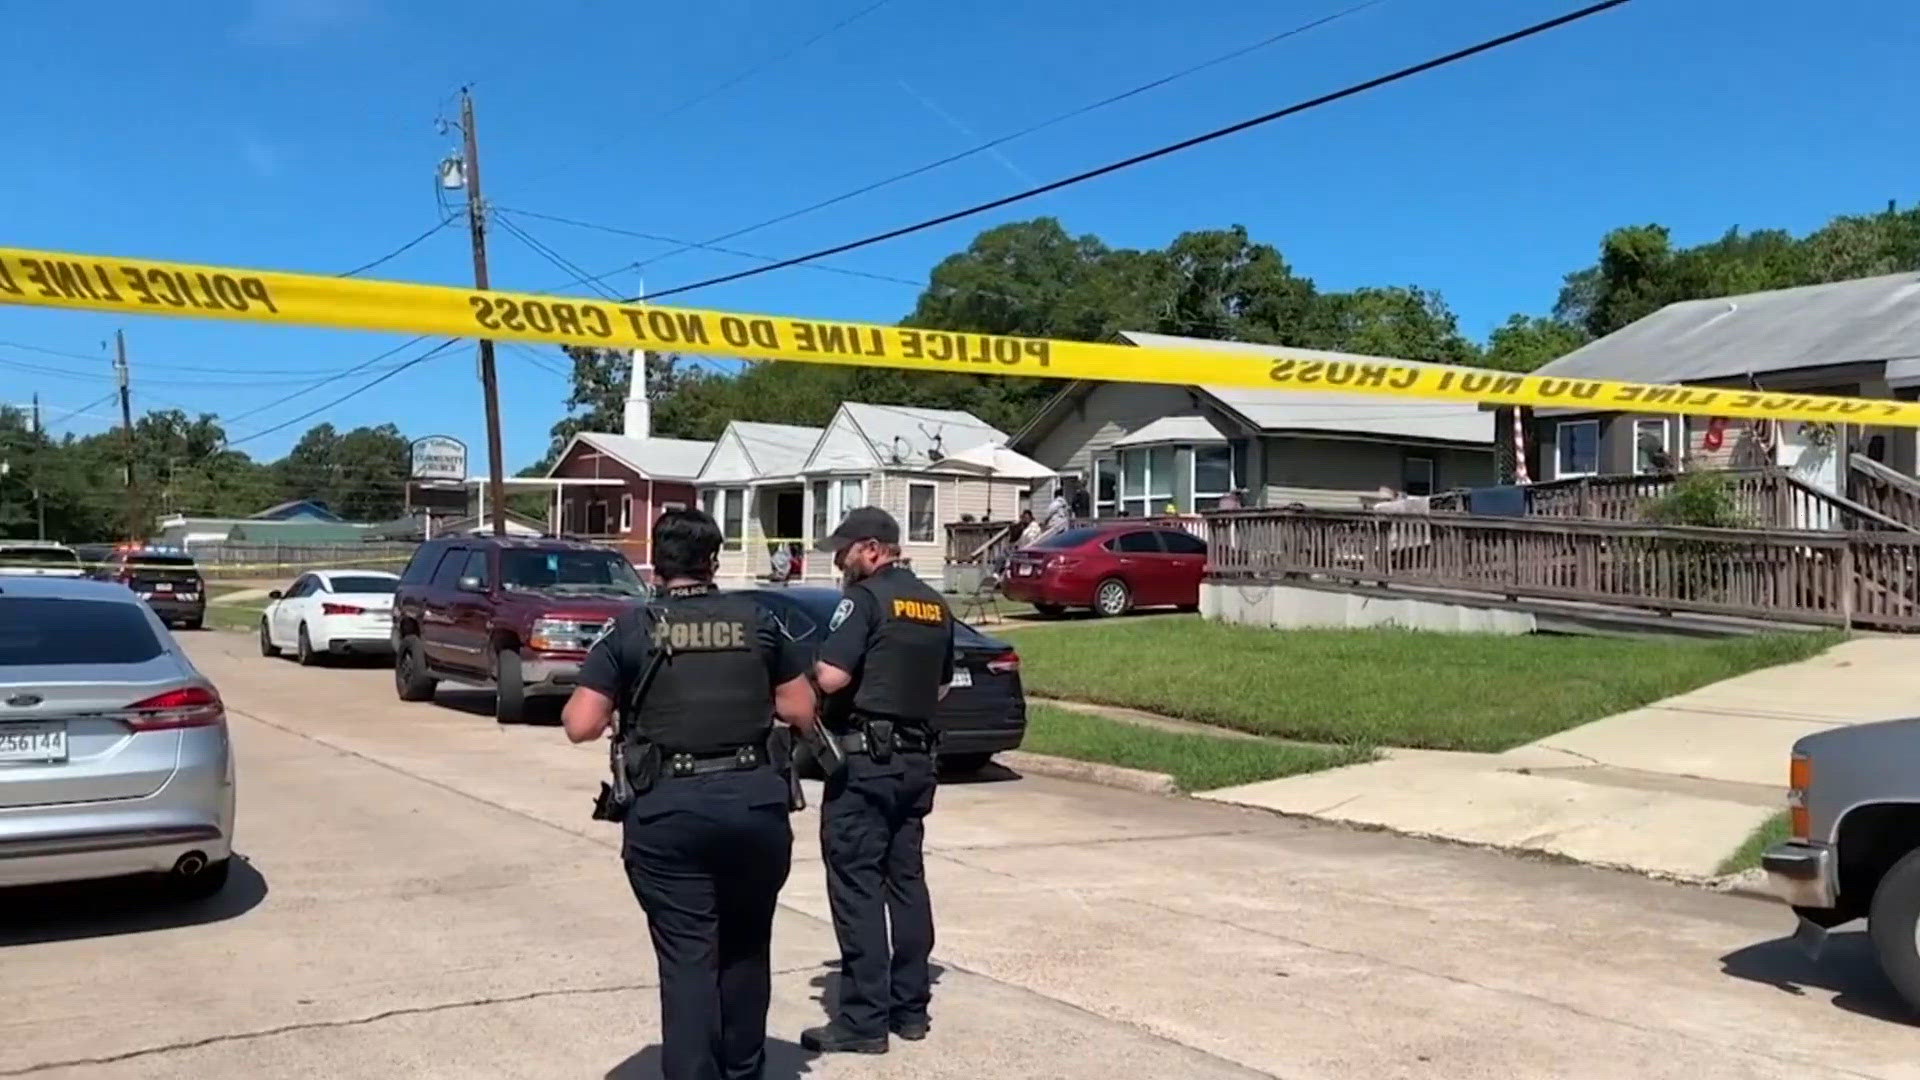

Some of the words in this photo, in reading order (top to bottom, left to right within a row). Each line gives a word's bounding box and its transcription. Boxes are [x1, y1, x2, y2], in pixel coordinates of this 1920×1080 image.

[670, 585, 709, 597] POLICE
[893, 599, 943, 622] POLICE
[653, 621, 745, 649] POLICE
